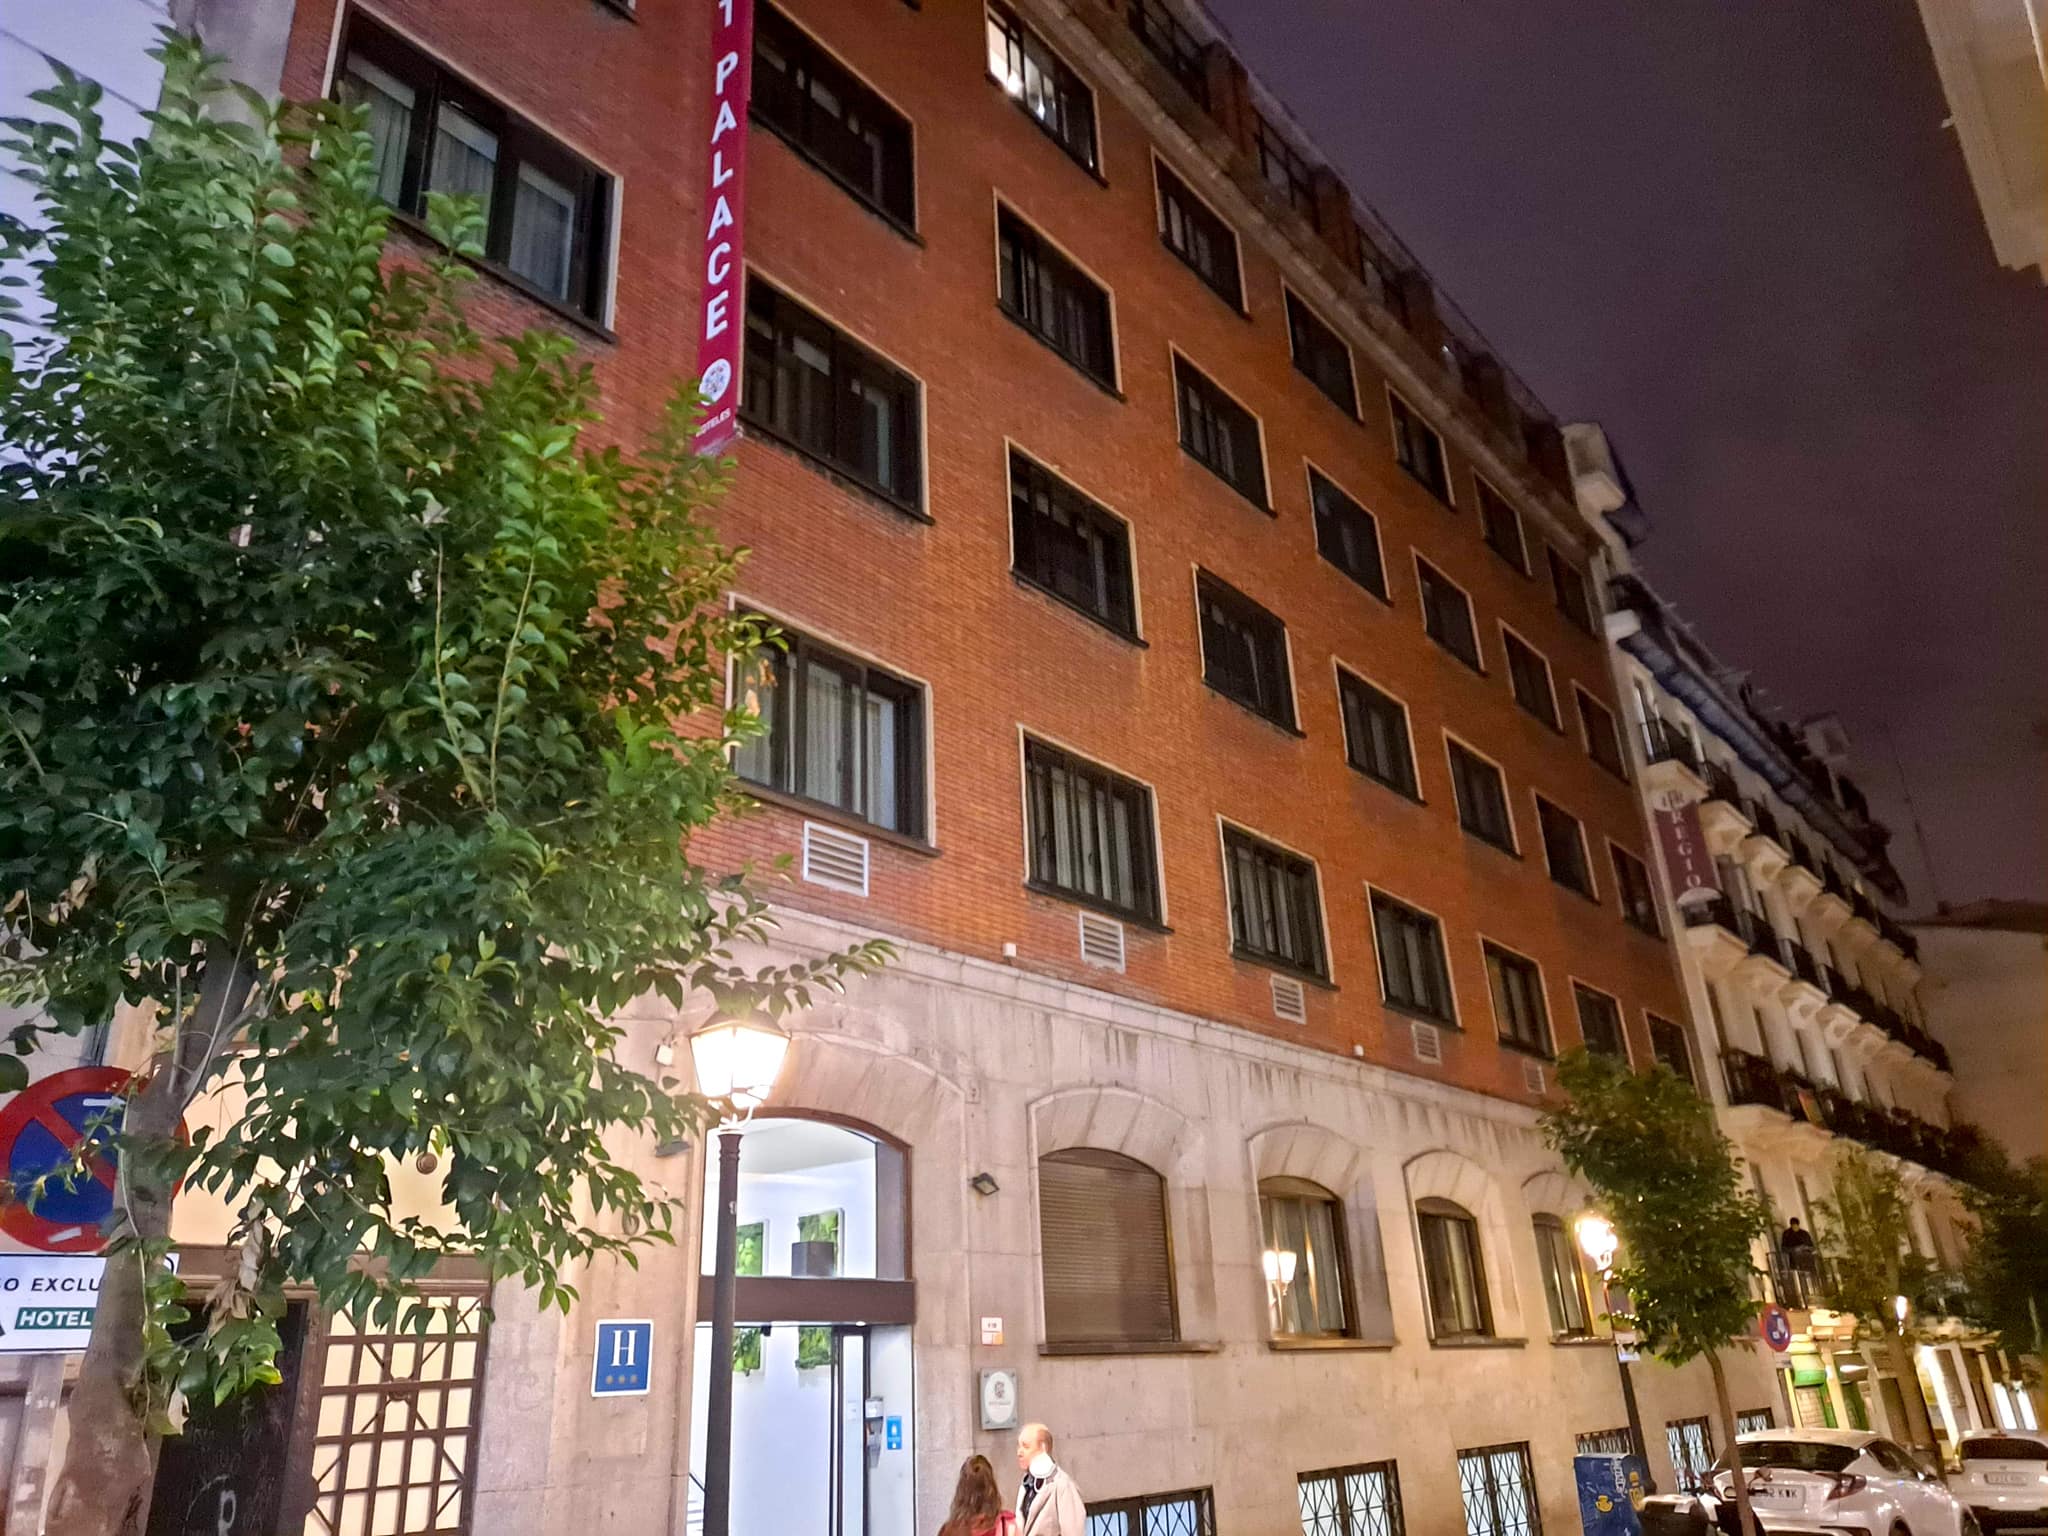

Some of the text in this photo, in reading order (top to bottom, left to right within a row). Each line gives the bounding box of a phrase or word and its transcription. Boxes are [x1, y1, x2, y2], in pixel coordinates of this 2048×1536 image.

[706, 51, 739, 341] PALACE
[19, 1310, 92, 1327] HOTEL
[610, 1329, 638, 1367] H
